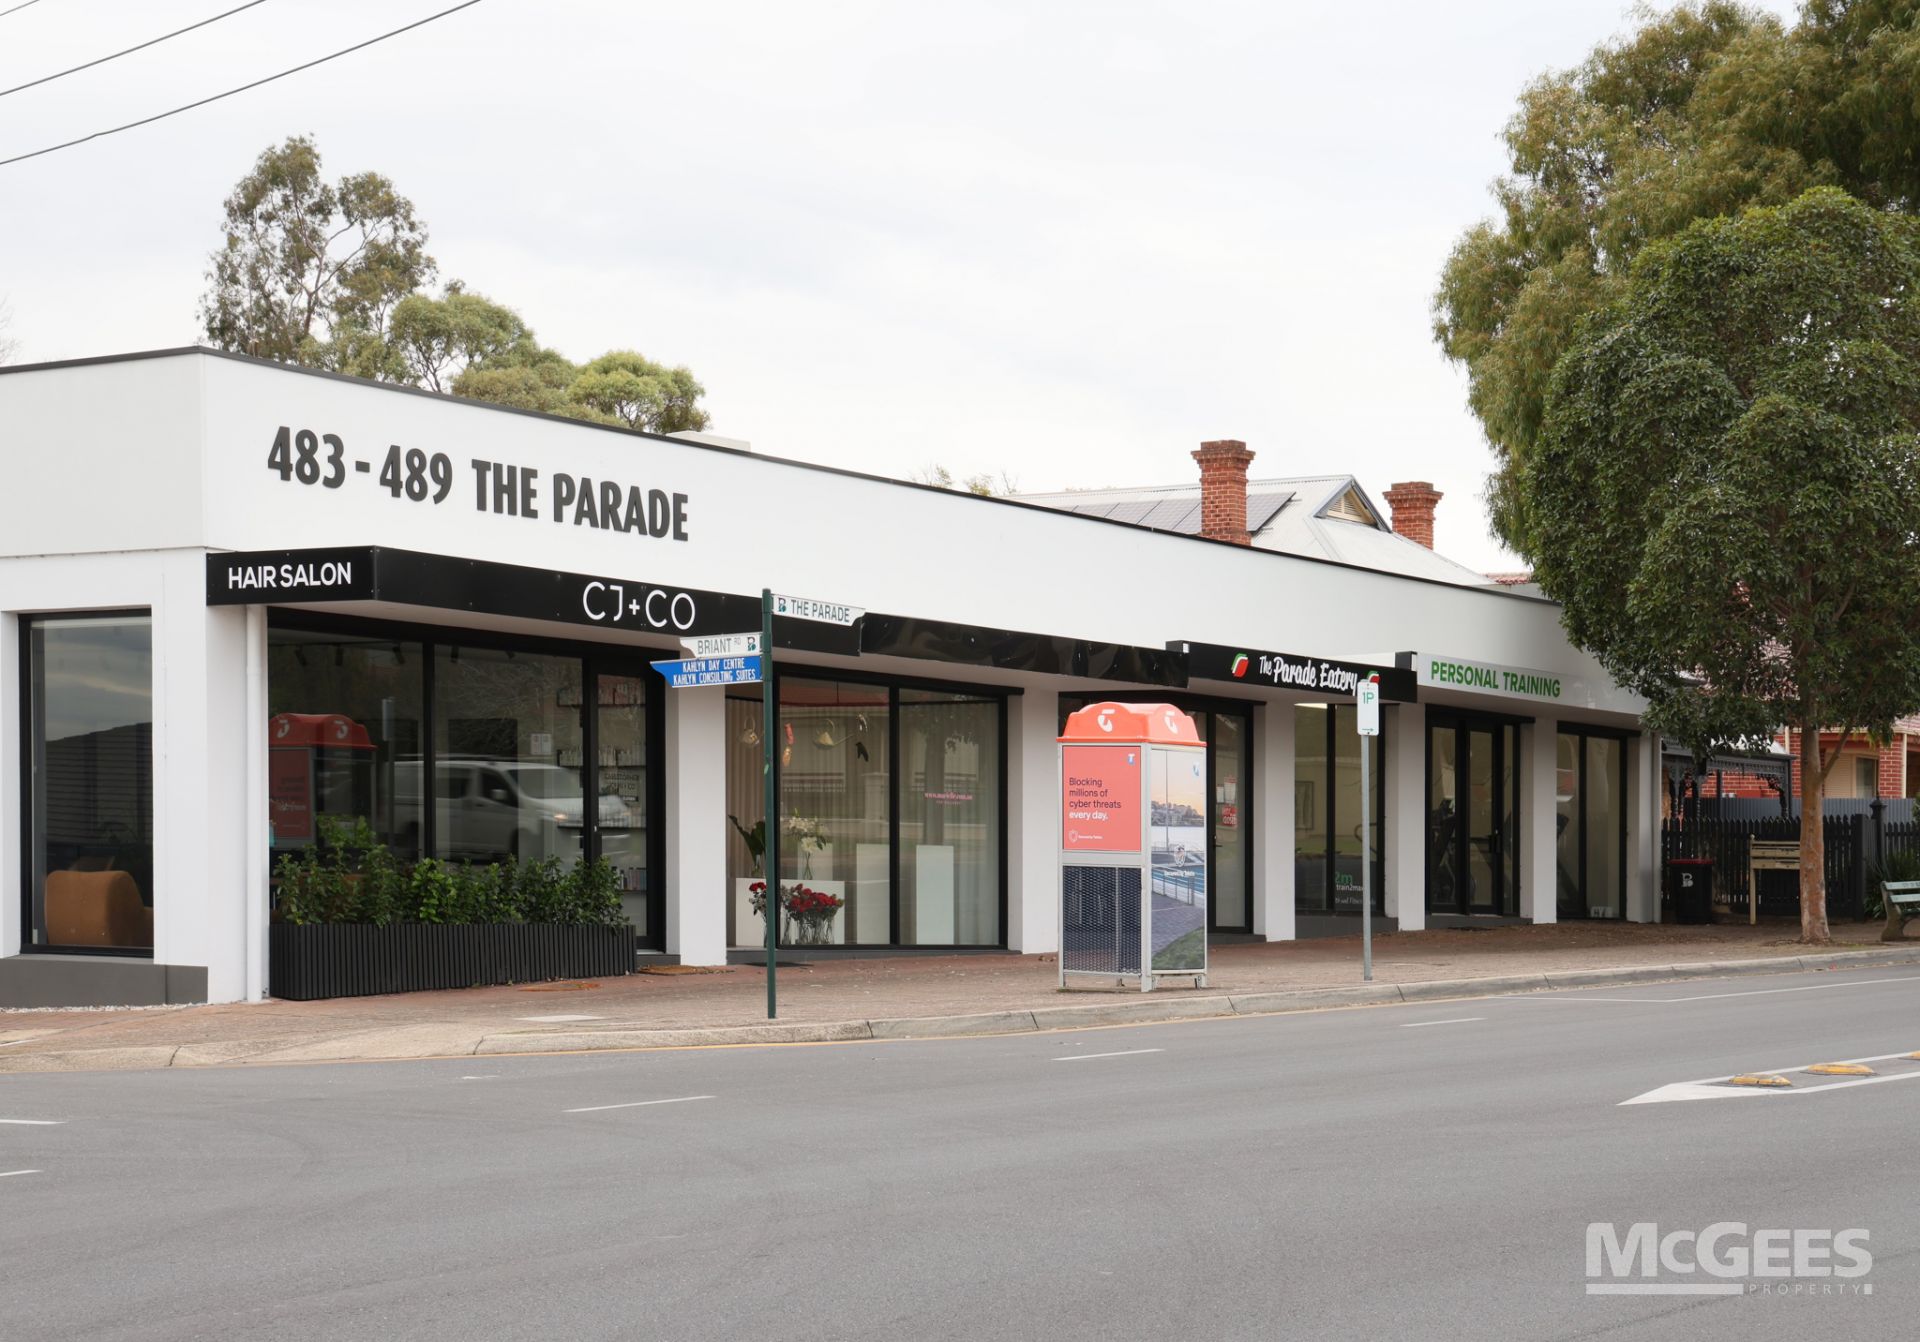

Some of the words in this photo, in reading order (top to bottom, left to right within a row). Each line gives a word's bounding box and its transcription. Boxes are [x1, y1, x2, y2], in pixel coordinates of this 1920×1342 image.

[471, 458, 538, 519] THE
[553, 472, 689, 542] PARADE
[228, 565, 277, 589] HAIR
[280, 562, 352, 588] SALON
[583, 581, 696, 630] CJ+CO
[791, 599, 809, 617] THE
[812, 602, 850, 623] PARADE
[697, 638, 732, 655] BRIANT
[682, 660, 706, 673] KAHLYN
[709, 659, 720, 672] DAY
[723, 657, 745, 670] CENTRE
[673, 673, 697, 686] KAHLYN
[699, 670, 734, 684] CONSULTING
[736, 668, 756, 681] SUITES
[1259, 655, 1273, 676] The
[1273, 656, 1317, 688] Parade
[1320, 662, 1358, 697] Eatery
[1431, 661, 1499, 690] PERSONAL
[1503, 671, 1561, 698] TRAINING
[1362, 691, 1375, 705] 1P
[1069, 777, 1103, 788] Blocking
[1069, 789, 1098, 798] millions
[1099, 789, 1108, 798] of
[1069, 799, 1091, 809] cyber
[1093, 800, 1122, 809] threats
[1069, 811, 1091, 821] every
[1092, 811, 1108, 821] day.
